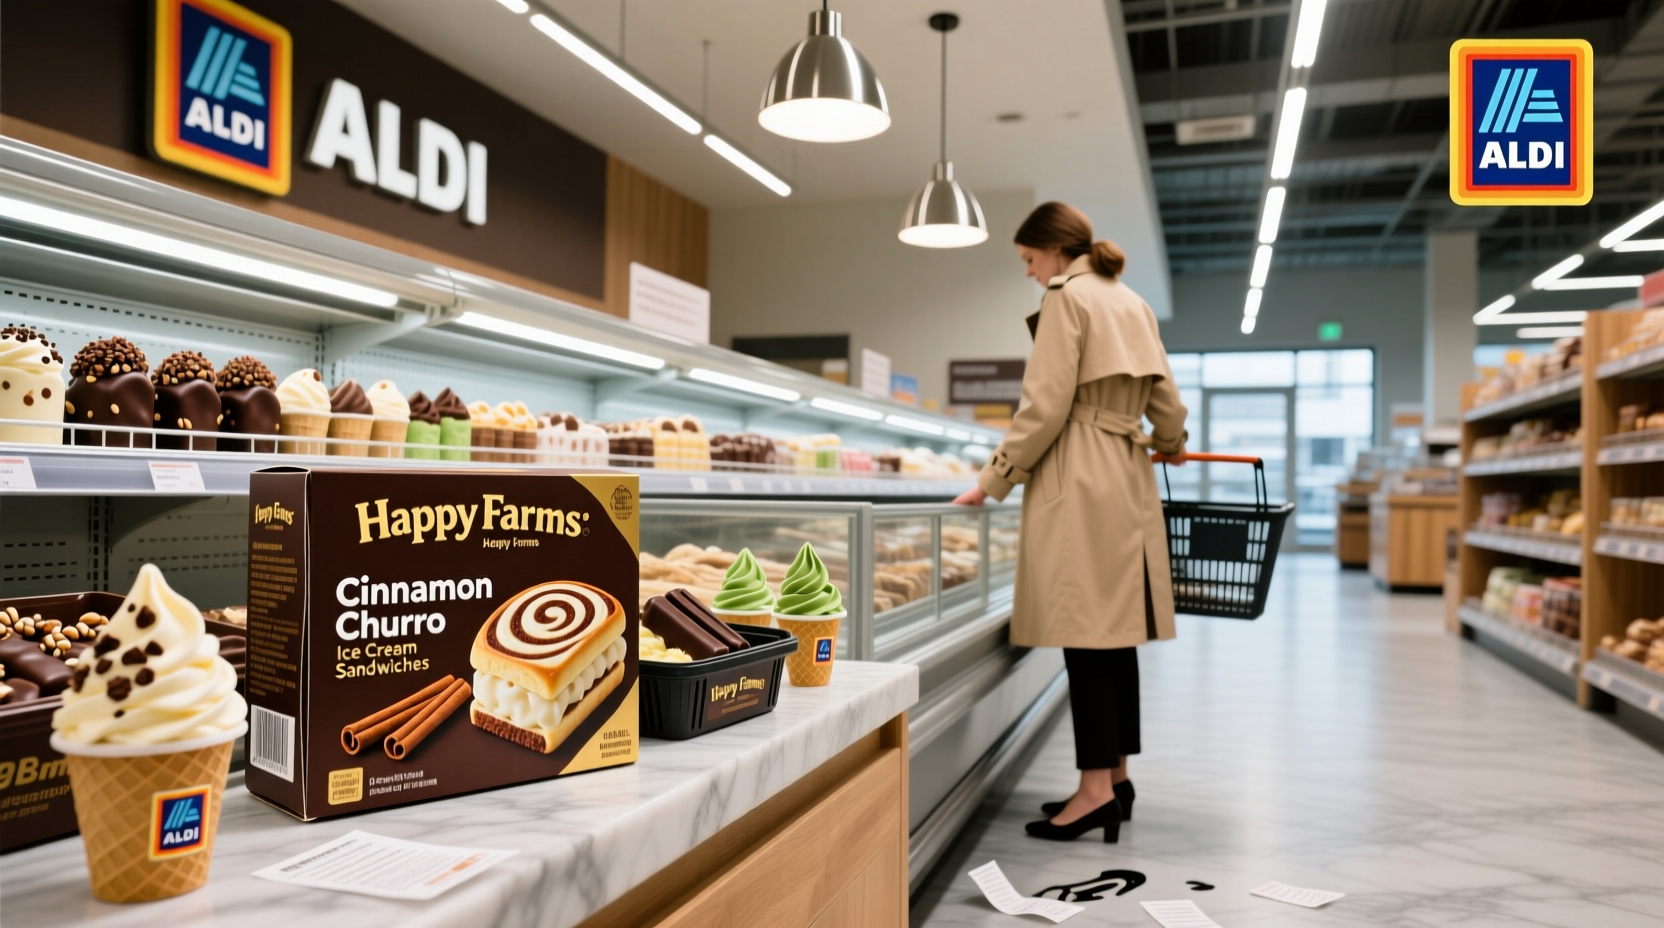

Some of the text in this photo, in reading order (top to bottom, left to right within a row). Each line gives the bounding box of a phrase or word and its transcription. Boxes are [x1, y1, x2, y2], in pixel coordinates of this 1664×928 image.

[184, 96, 265, 151] ALDI
[309, 77, 488, 226] ALDI
[354, 498, 479, 544] Happy
[335, 574, 493, 608] Cinnamon
[335, 609, 446, 641] Churro
[335, 656, 430, 679] Sandwiches
[337, 642, 417, 661] Ice Cream
[162, 826, 200, 846] ALDI
